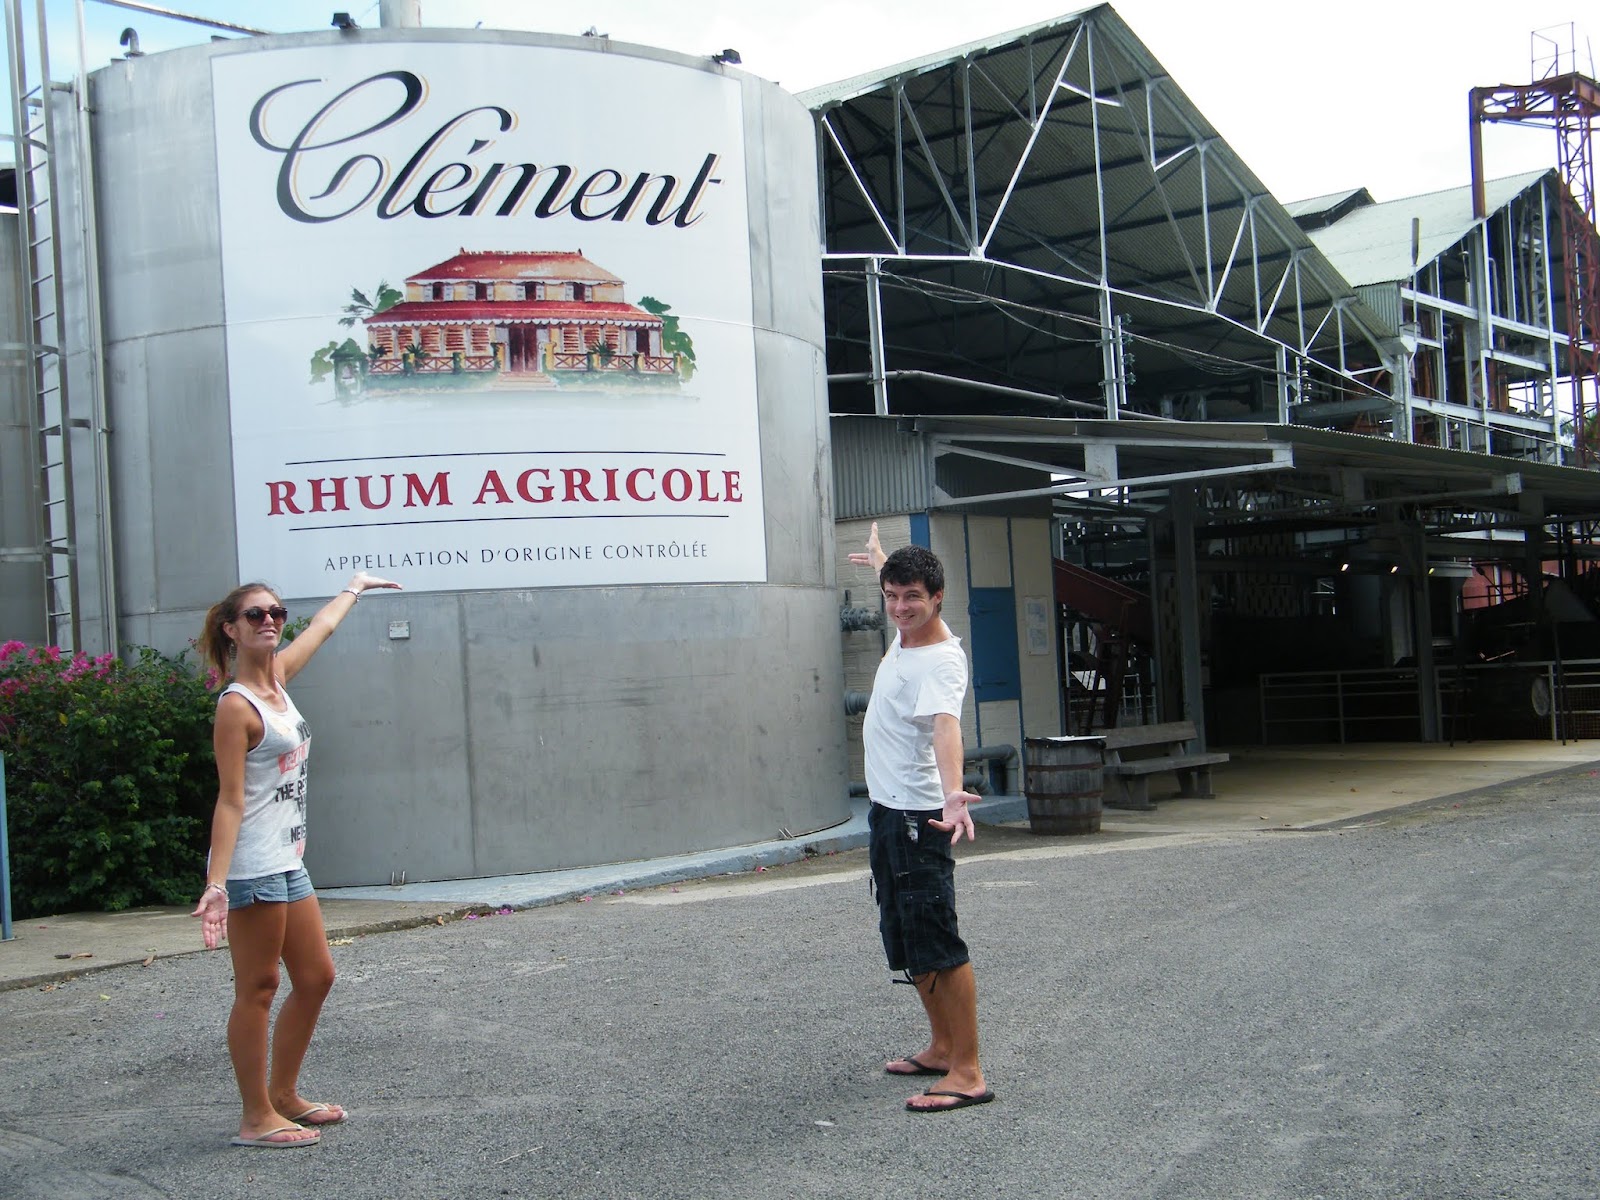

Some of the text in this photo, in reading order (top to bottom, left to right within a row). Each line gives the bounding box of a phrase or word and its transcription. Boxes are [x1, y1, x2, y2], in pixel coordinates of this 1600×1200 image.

[249, 70, 723, 229] Clément
[265, 467, 743, 516] RHUM AGRICOLE
[324, 540, 708, 571] APPELLATION D'ORIGINE CONTRÔLÉE
